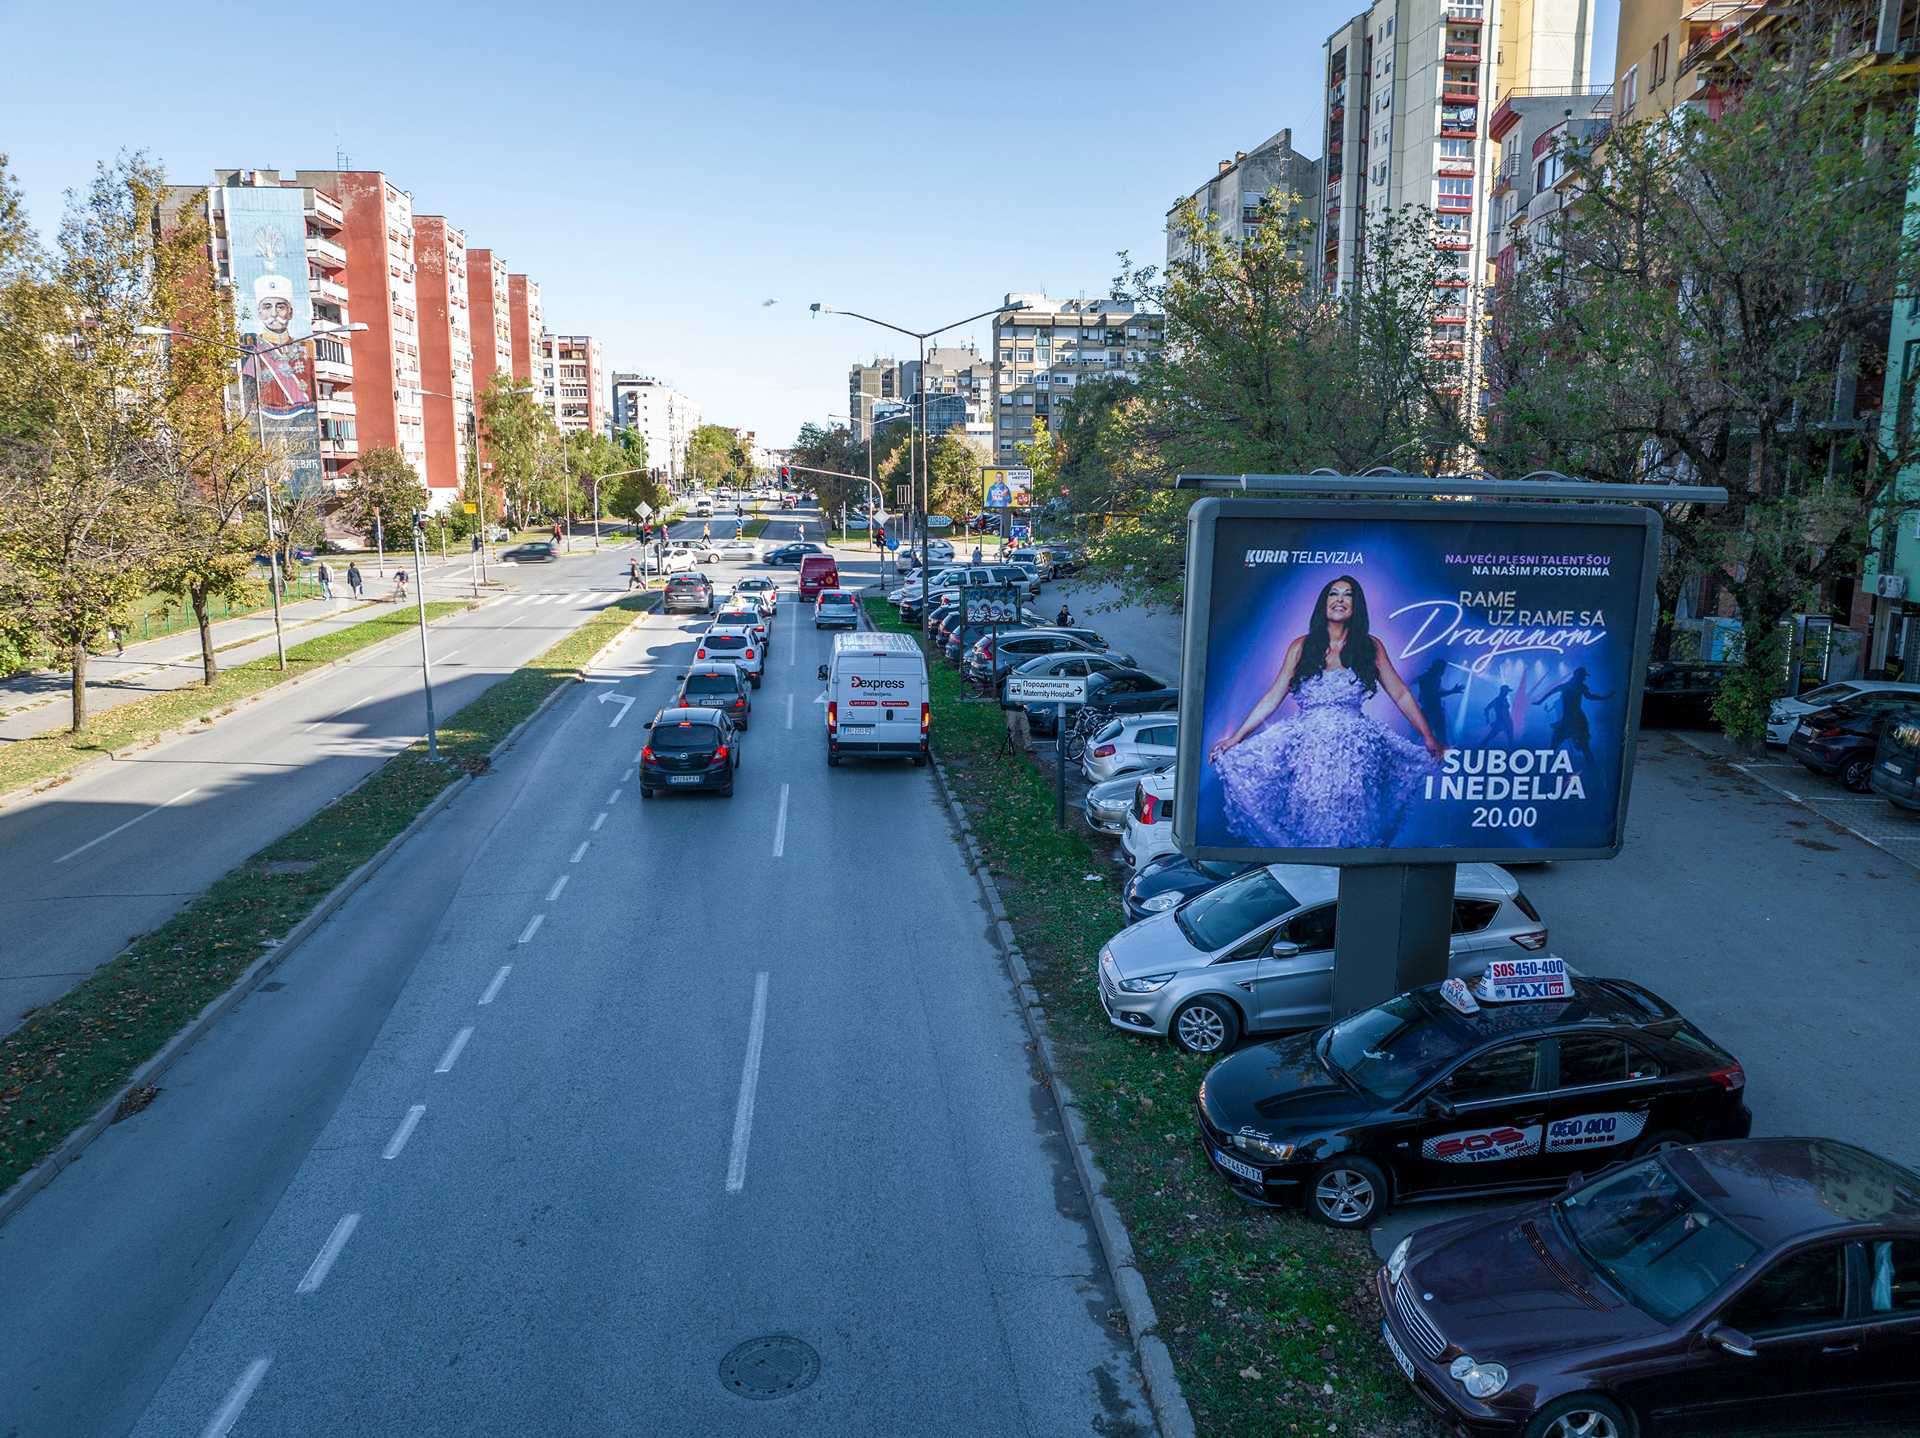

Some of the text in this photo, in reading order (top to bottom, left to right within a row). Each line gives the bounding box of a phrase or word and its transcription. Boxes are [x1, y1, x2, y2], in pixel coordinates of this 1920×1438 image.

[1245, 549, 1363, 564] KURIR TELEVIZIJA
[1445, 554, 1611, 565] NAJVEĆI PLESNI TALENT ŠOU
[1472, 564, 1610, 576] NA NAŠIM PROSTORIMA
[1459, 591, 1516, 607] RAME
[1488, 610, 1605, 626] UZ RAME SA
[1389, 600, 1607, 672] Draganom
[1023, 681, 1069, 689] Породилиште
[1023, 690, 1074, 699] Maternity Hospital
[1442, 749, 1573, 774] SUBOTA
[1425, 775, 1586, 800] I NEDELJA
[1471, 807, 1537, 827] 20.00
[1506, 982, 1564, 998] TAXI 021
[1550, 1117, 1617, 1138] 450 400
[1435, 1127, 1525, 1156] SOS
[1468, 1148, 1499, 1162] TAXI
